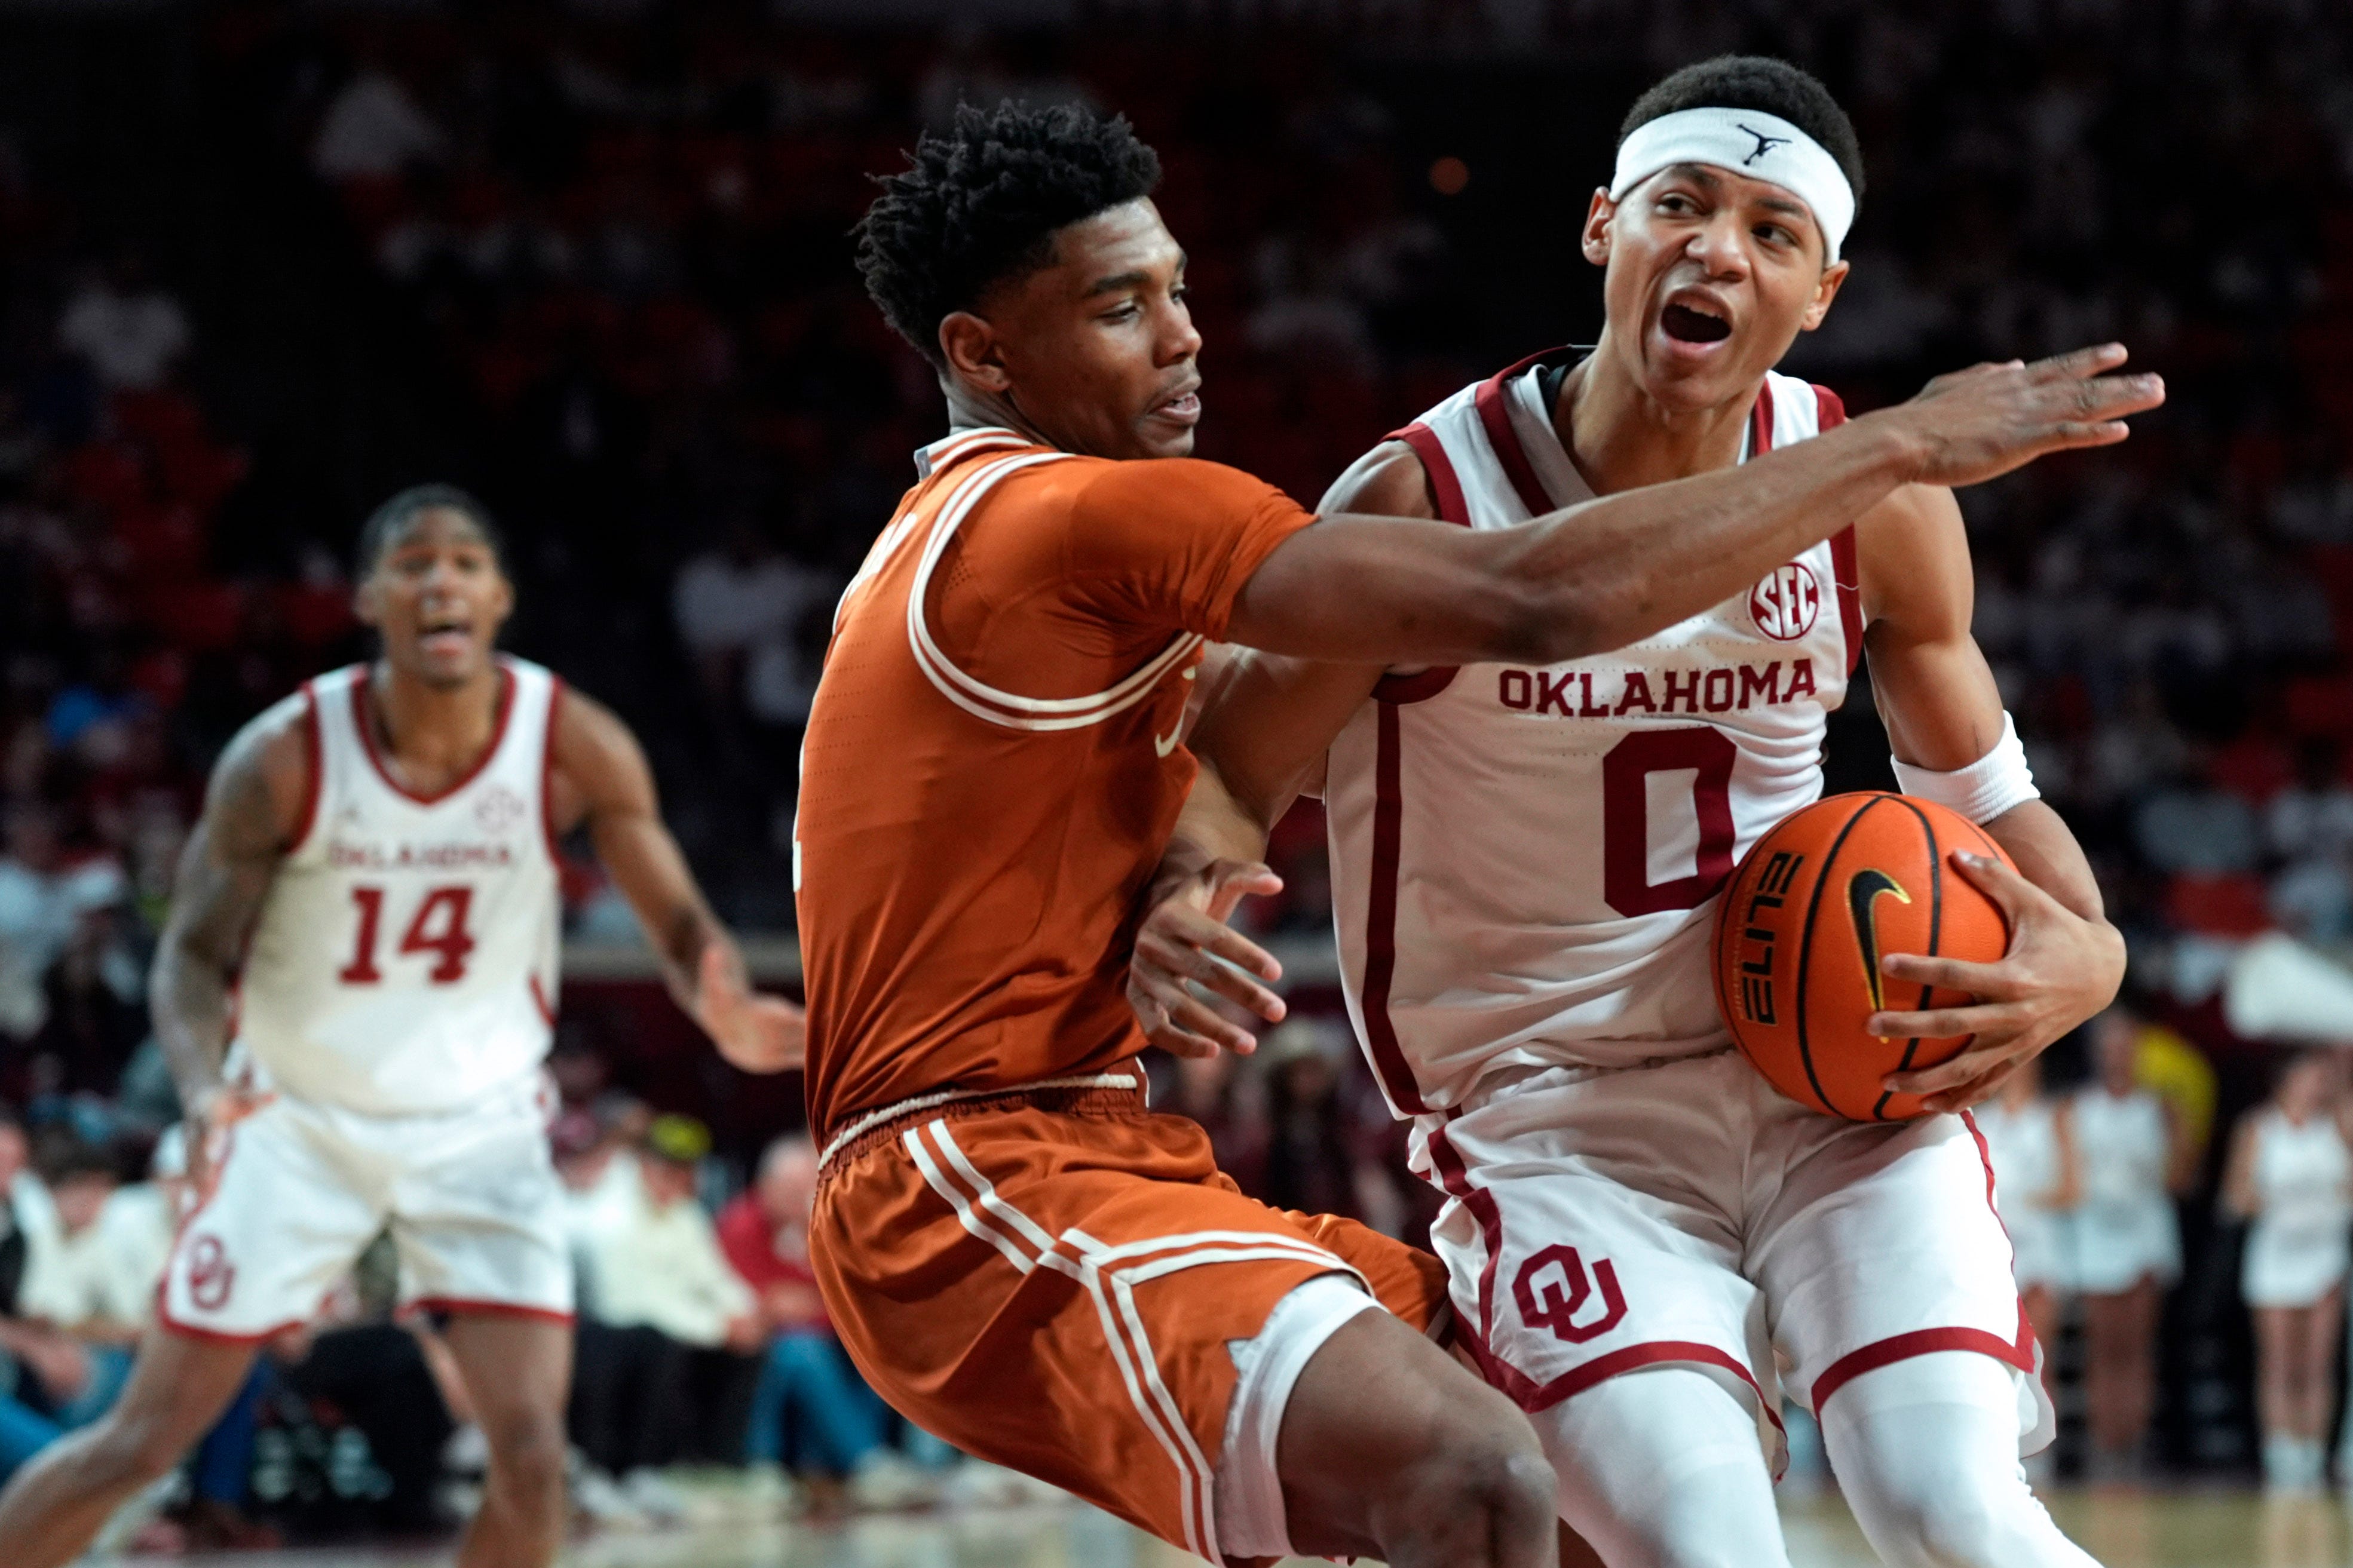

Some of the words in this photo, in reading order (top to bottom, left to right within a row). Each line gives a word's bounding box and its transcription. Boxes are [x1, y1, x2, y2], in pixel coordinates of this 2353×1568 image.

[1754, 566, 1817, 637] SEC
[1499, 658, 1817, 717] OKLAHOMA
[1604, 726, 1736, 918] 0
[337, 886, 476, 984] 14
[1742, 852, 1805, 1025] ELITE
[1512, 1243, 1628, 1344] OU
